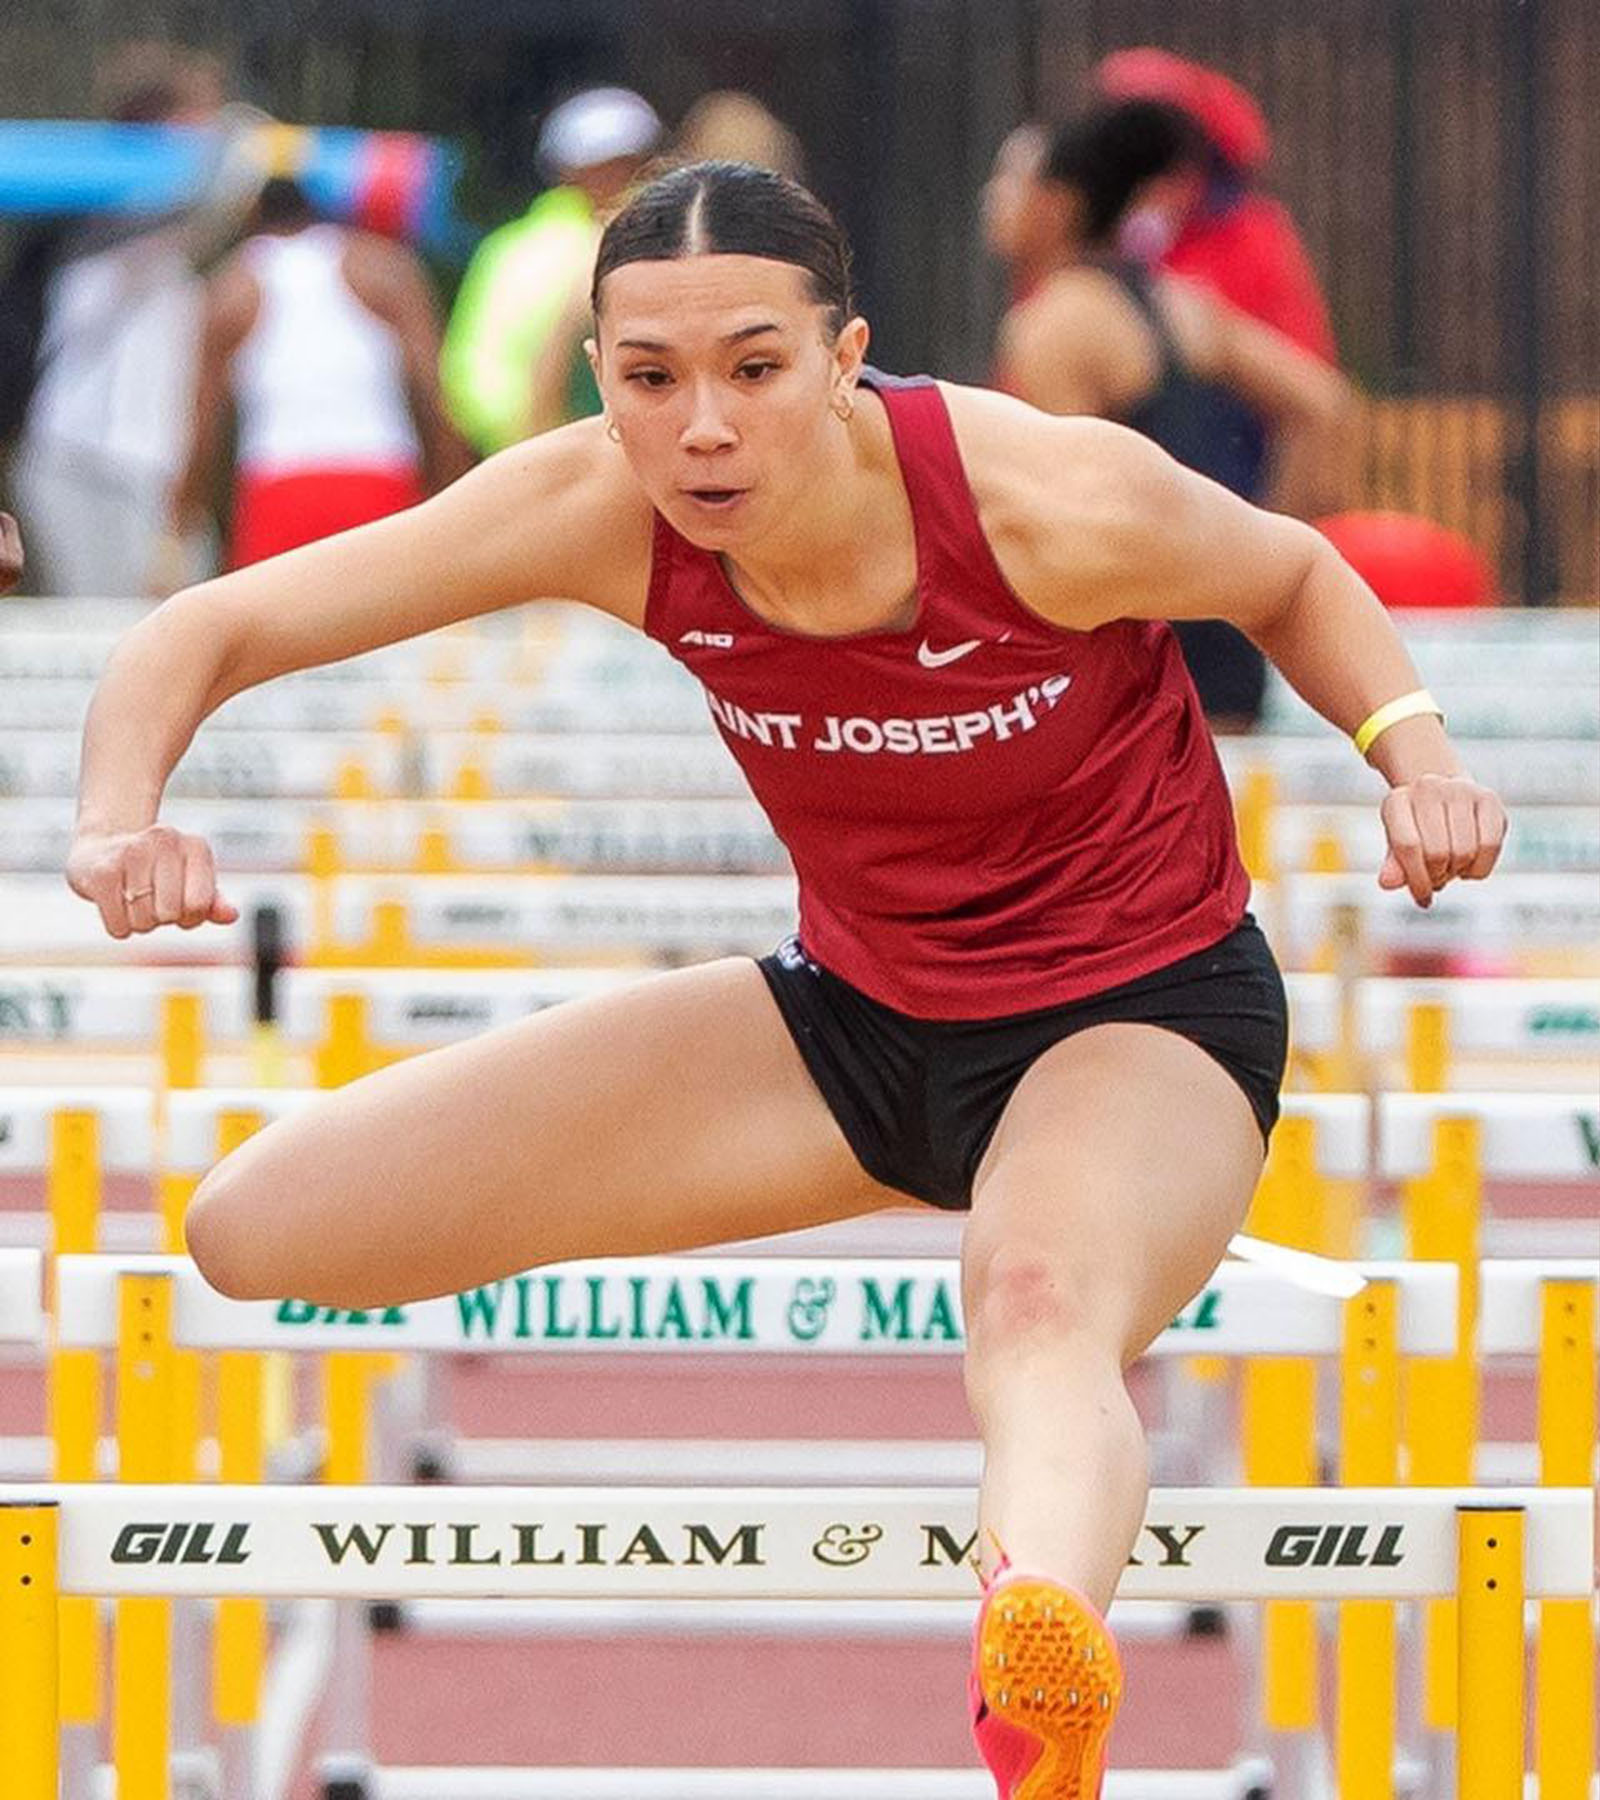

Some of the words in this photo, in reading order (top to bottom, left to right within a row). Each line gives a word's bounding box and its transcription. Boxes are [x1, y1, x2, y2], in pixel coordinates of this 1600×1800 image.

[456, 1277, 757, 1338] WILLIAM
[787, 1277, 835, 1341] &
[859, 1277, 962, 1339] MA
[110, 1523, 253, 1565] GILL
[310, 1524, 767, 1566] WILLIAM
[812, 1524, 884, 1567] &
[918, 1524, 1206, 1567] MY
[1264, 1525, 1406, 1567] GILL
